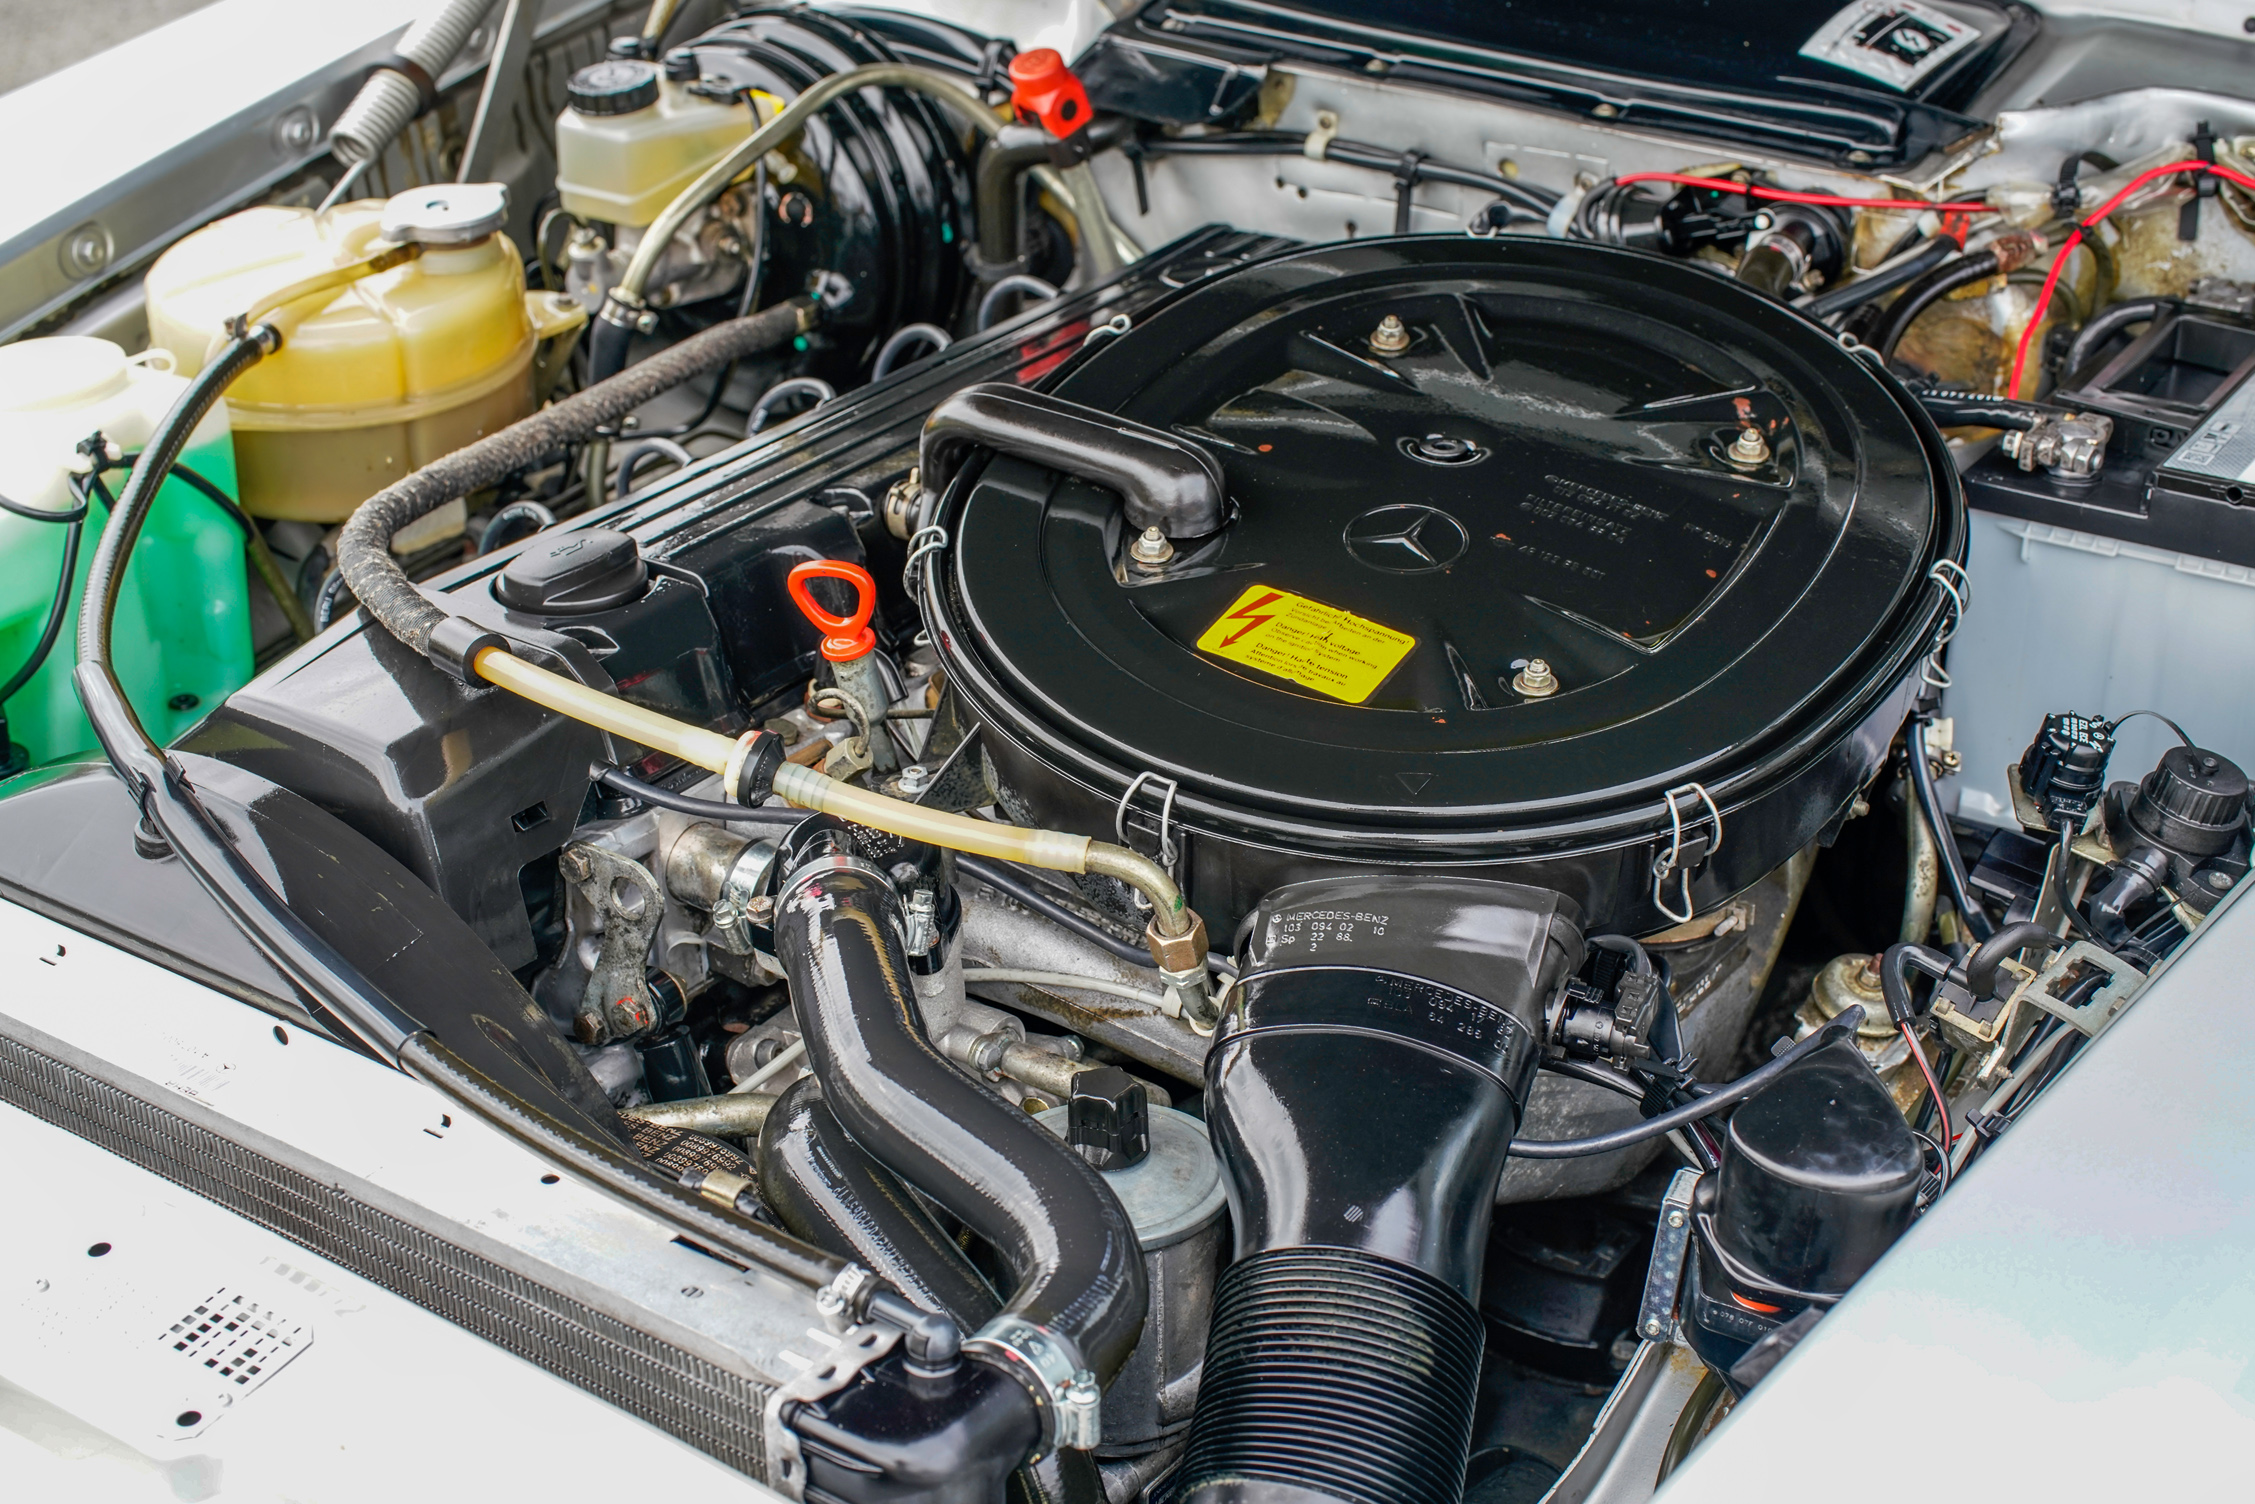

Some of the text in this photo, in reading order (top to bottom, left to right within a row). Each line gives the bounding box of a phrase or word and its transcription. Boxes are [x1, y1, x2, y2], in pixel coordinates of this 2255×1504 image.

[1526, 494, 1631, 534] FILTEREINSATZ
[1287, 911, 1390, 926] MERCEDES-BENZ
[1284, 922, 1385, 936] 103 094 02 10
[1310, 932, 1325, 941] 22
[1309, 943, 1318, 952] 2
[1390, 978, 1515, 1030] MERCEDES-BENZ
[1428, 997, 1454, 1013] 094
[1471, 1012, 1486, 1025] 17
